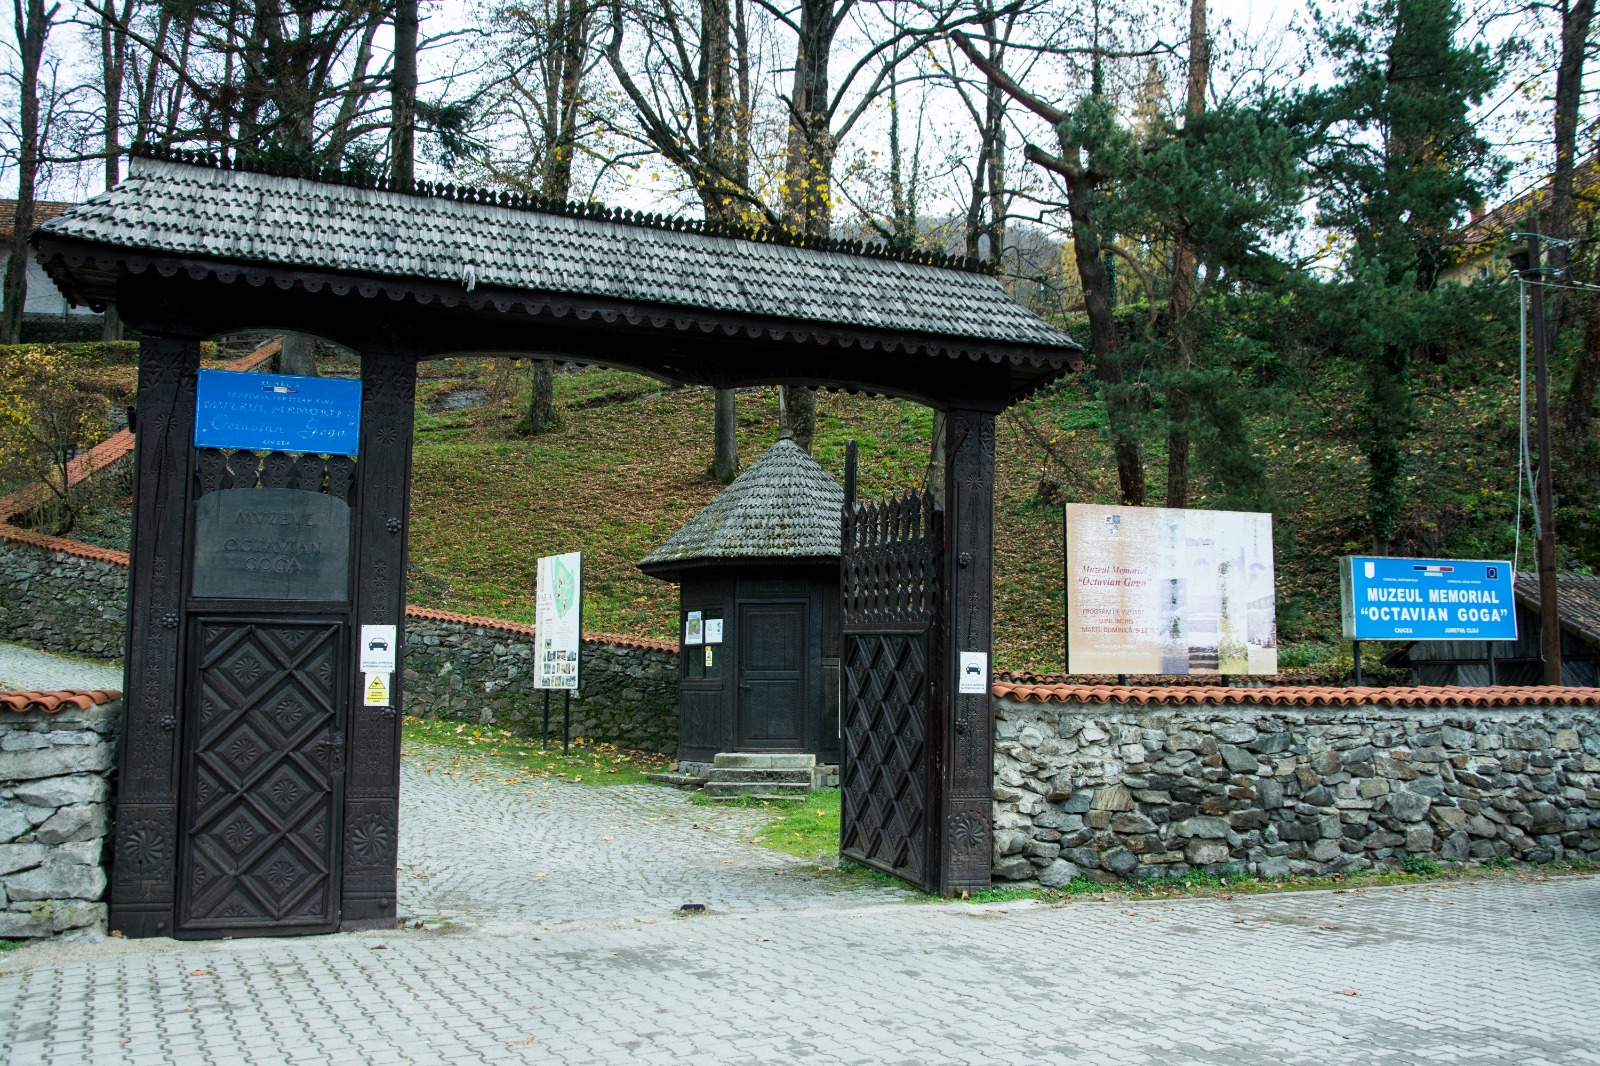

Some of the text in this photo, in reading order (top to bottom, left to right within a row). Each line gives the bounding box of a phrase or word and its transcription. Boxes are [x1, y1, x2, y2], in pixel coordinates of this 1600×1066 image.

[224, 538, 322, 554] OCTAVIAN
[245, 556, 302, 572] GOGA
[1082, 566, 1110, 574] Muzeul
[1367, 588, 1500, 603] MUZEUL MEMORIAL
[1361, 606, 1508, 622] “OCTAVIAN GOGA”
